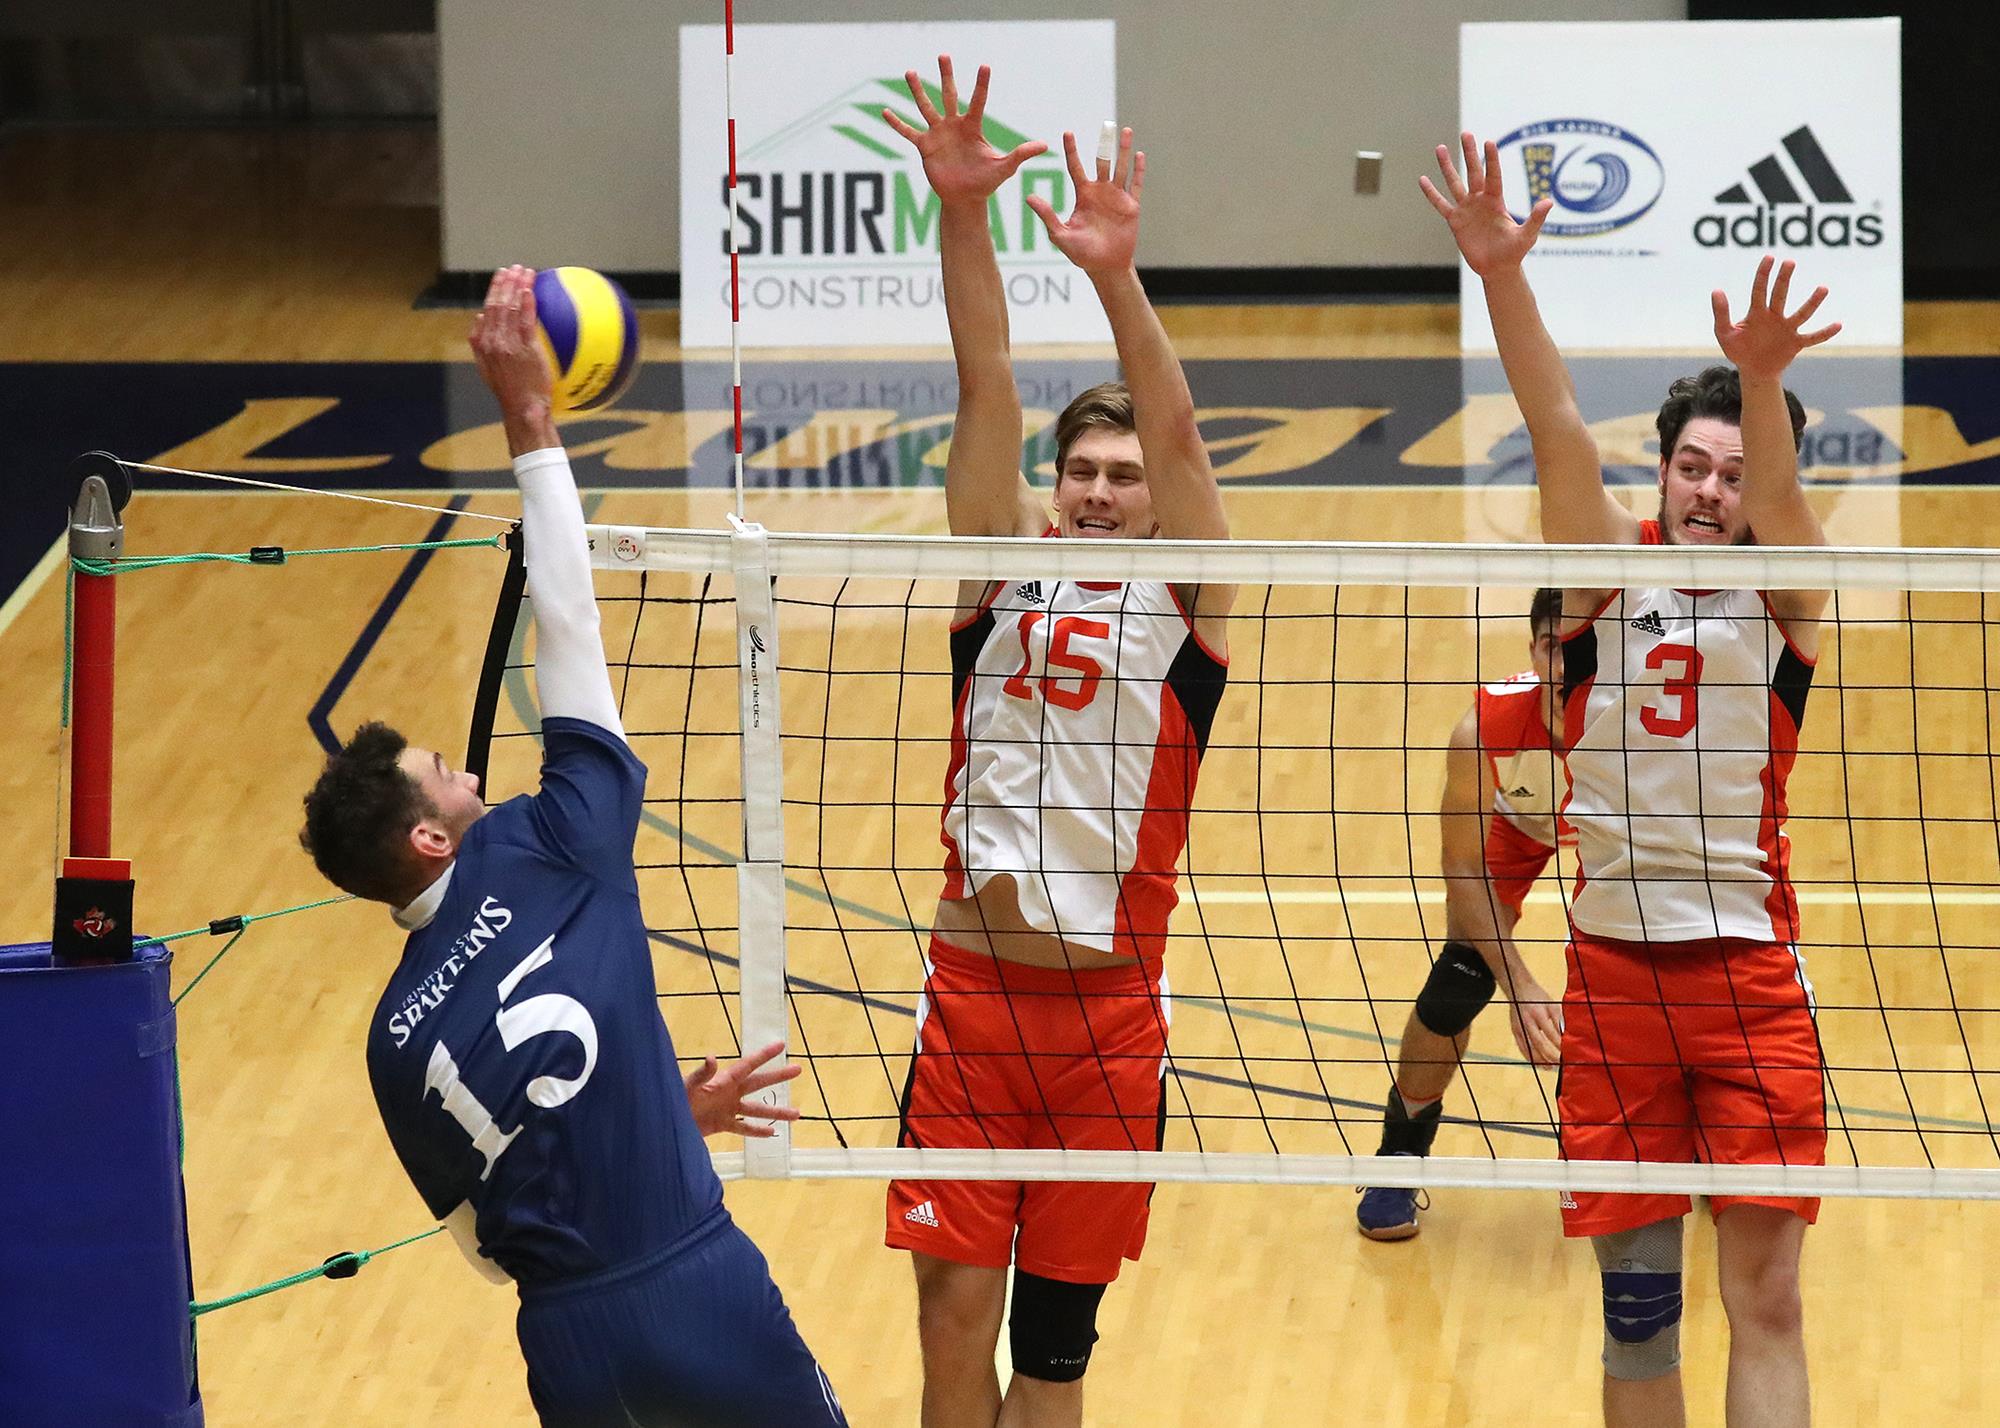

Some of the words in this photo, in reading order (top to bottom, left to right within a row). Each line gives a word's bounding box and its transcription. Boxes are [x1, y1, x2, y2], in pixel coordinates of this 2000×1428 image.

[1692, 205, 1884, 248] adidas
[720, 273, 1072, 310] CONSTRUON
[1015, 588, 1046, 604] adidas
[1631, 620, 1666, 637] adidas
[1002, 611, 1110, 712] 15
[1639, 642, 1705, 739] 3
[388, 895, 513, 1050] SPARTNS
[402, 967, 442, 1009] TRINITY
[422, 933, 599, 1183] 15
[905, 1211, 940, 1228] adidas
